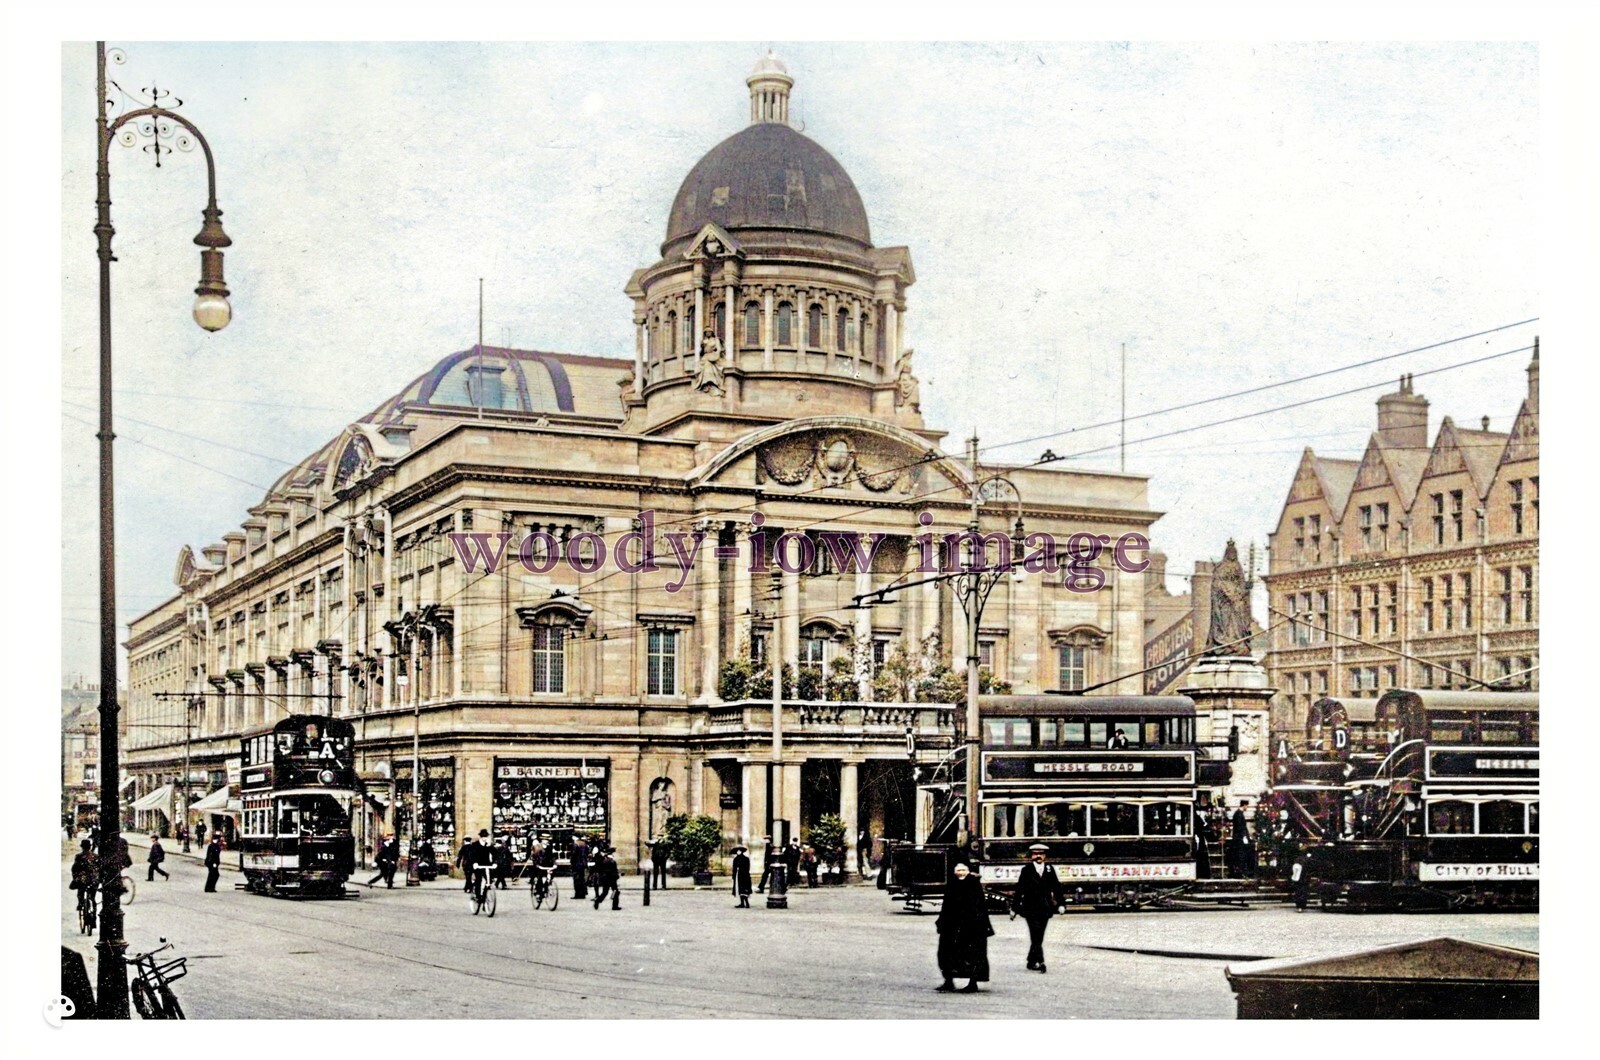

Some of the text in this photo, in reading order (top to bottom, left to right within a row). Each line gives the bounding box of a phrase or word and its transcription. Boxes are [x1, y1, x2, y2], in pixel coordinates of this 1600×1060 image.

[1146, 647, 1193, 693] HOTEL
[1335, 729, 1347, 748] D
[319, 742, 336, 759] A
[1277, 740, 1288, 759] A
[502, 766, 511, 776] B
[516, 766, 580, 777] BARNETT
[1043, 762, 1135, 772] HESSLE ROAD
[993, 866, 1021, 879] CIT
[1100, 865, 1180, 877] TRAMWAYS
[1435, 864, 1471, 876] CITY
[1497, 864, 1533, 876] HULL
